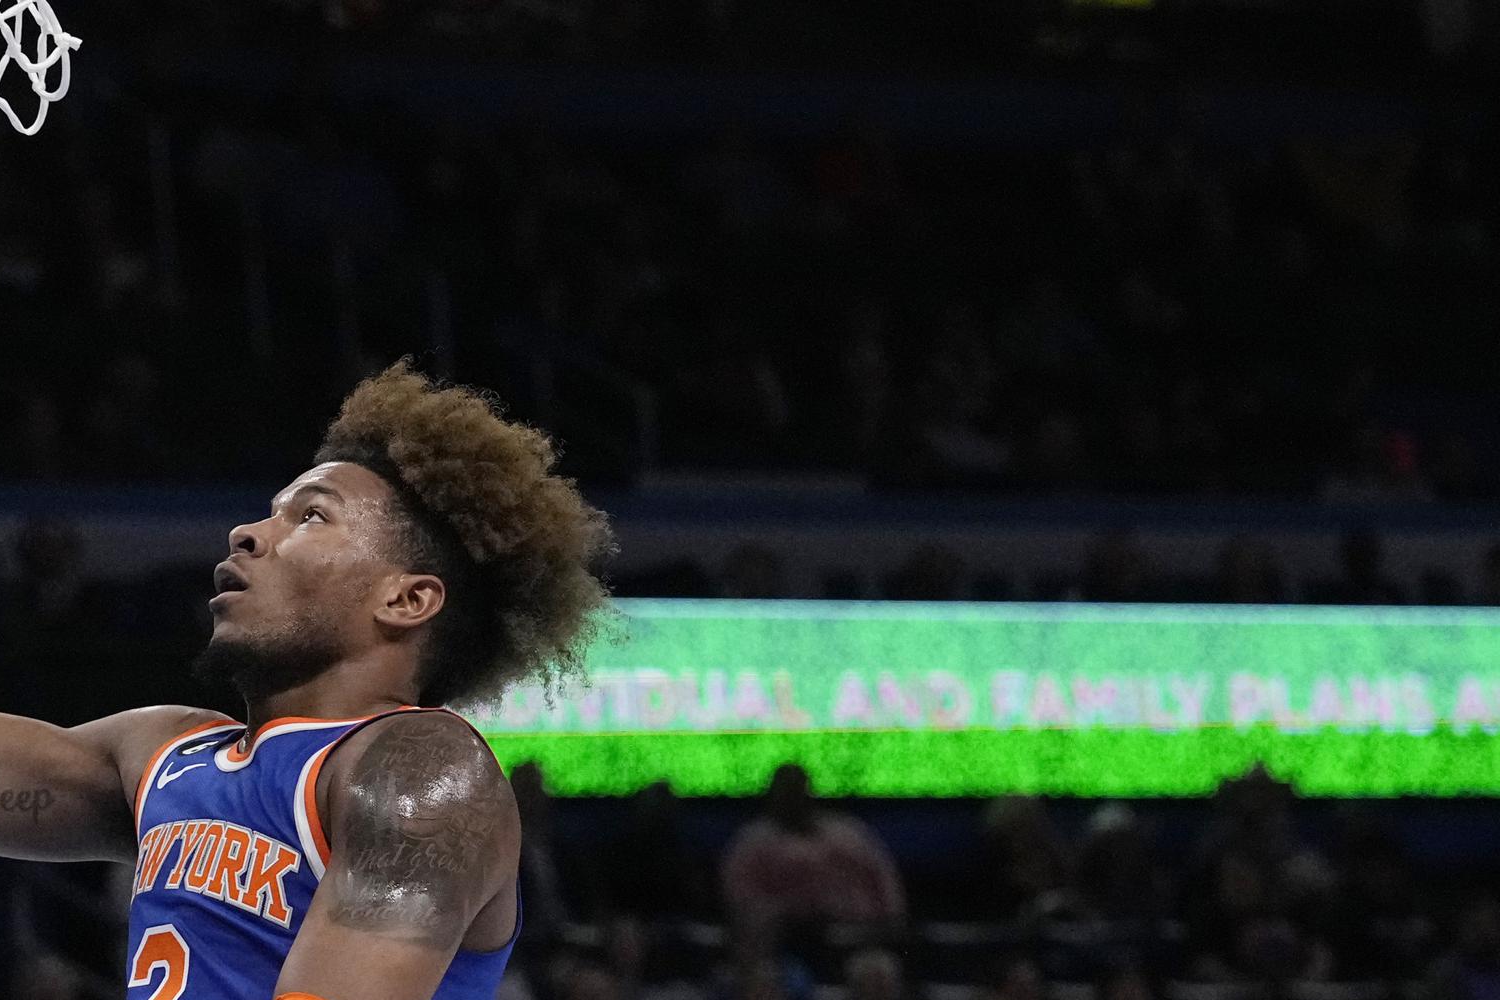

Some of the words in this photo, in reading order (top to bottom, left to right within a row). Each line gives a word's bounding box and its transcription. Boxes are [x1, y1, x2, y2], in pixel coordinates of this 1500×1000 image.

[475, 668, 811, 730] DIVIDUAL
[831, 669, 972, 731] AND
[990, 669, 1209, 733] FAMILY
[163, 818, 301, 930] YORK
